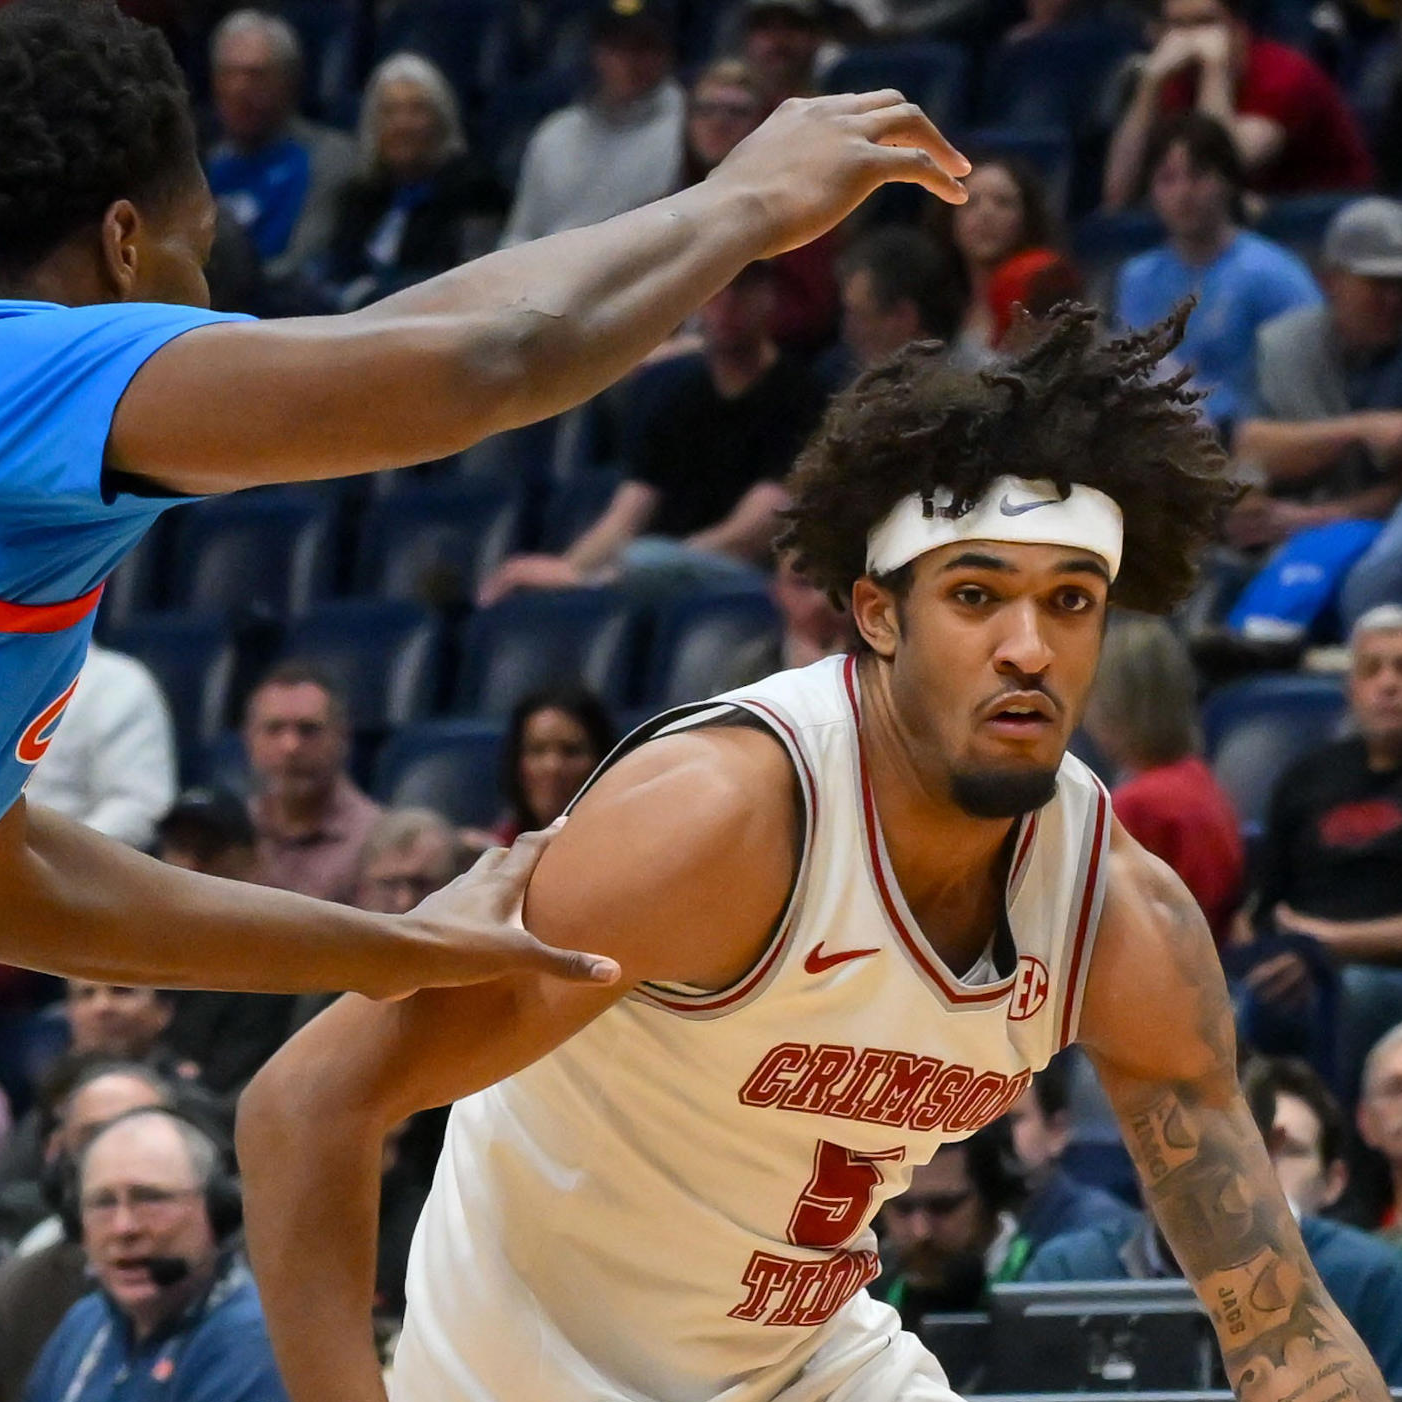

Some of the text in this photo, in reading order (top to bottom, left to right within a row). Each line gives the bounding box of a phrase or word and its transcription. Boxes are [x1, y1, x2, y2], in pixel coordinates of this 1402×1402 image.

[1008, 955, 1049, 1021] EC
[738, 1042, 1031, 1133] CRIMSON
[786, 1139, 906, 1250] 5
[728, 1248, 880, 1327] TIDE
